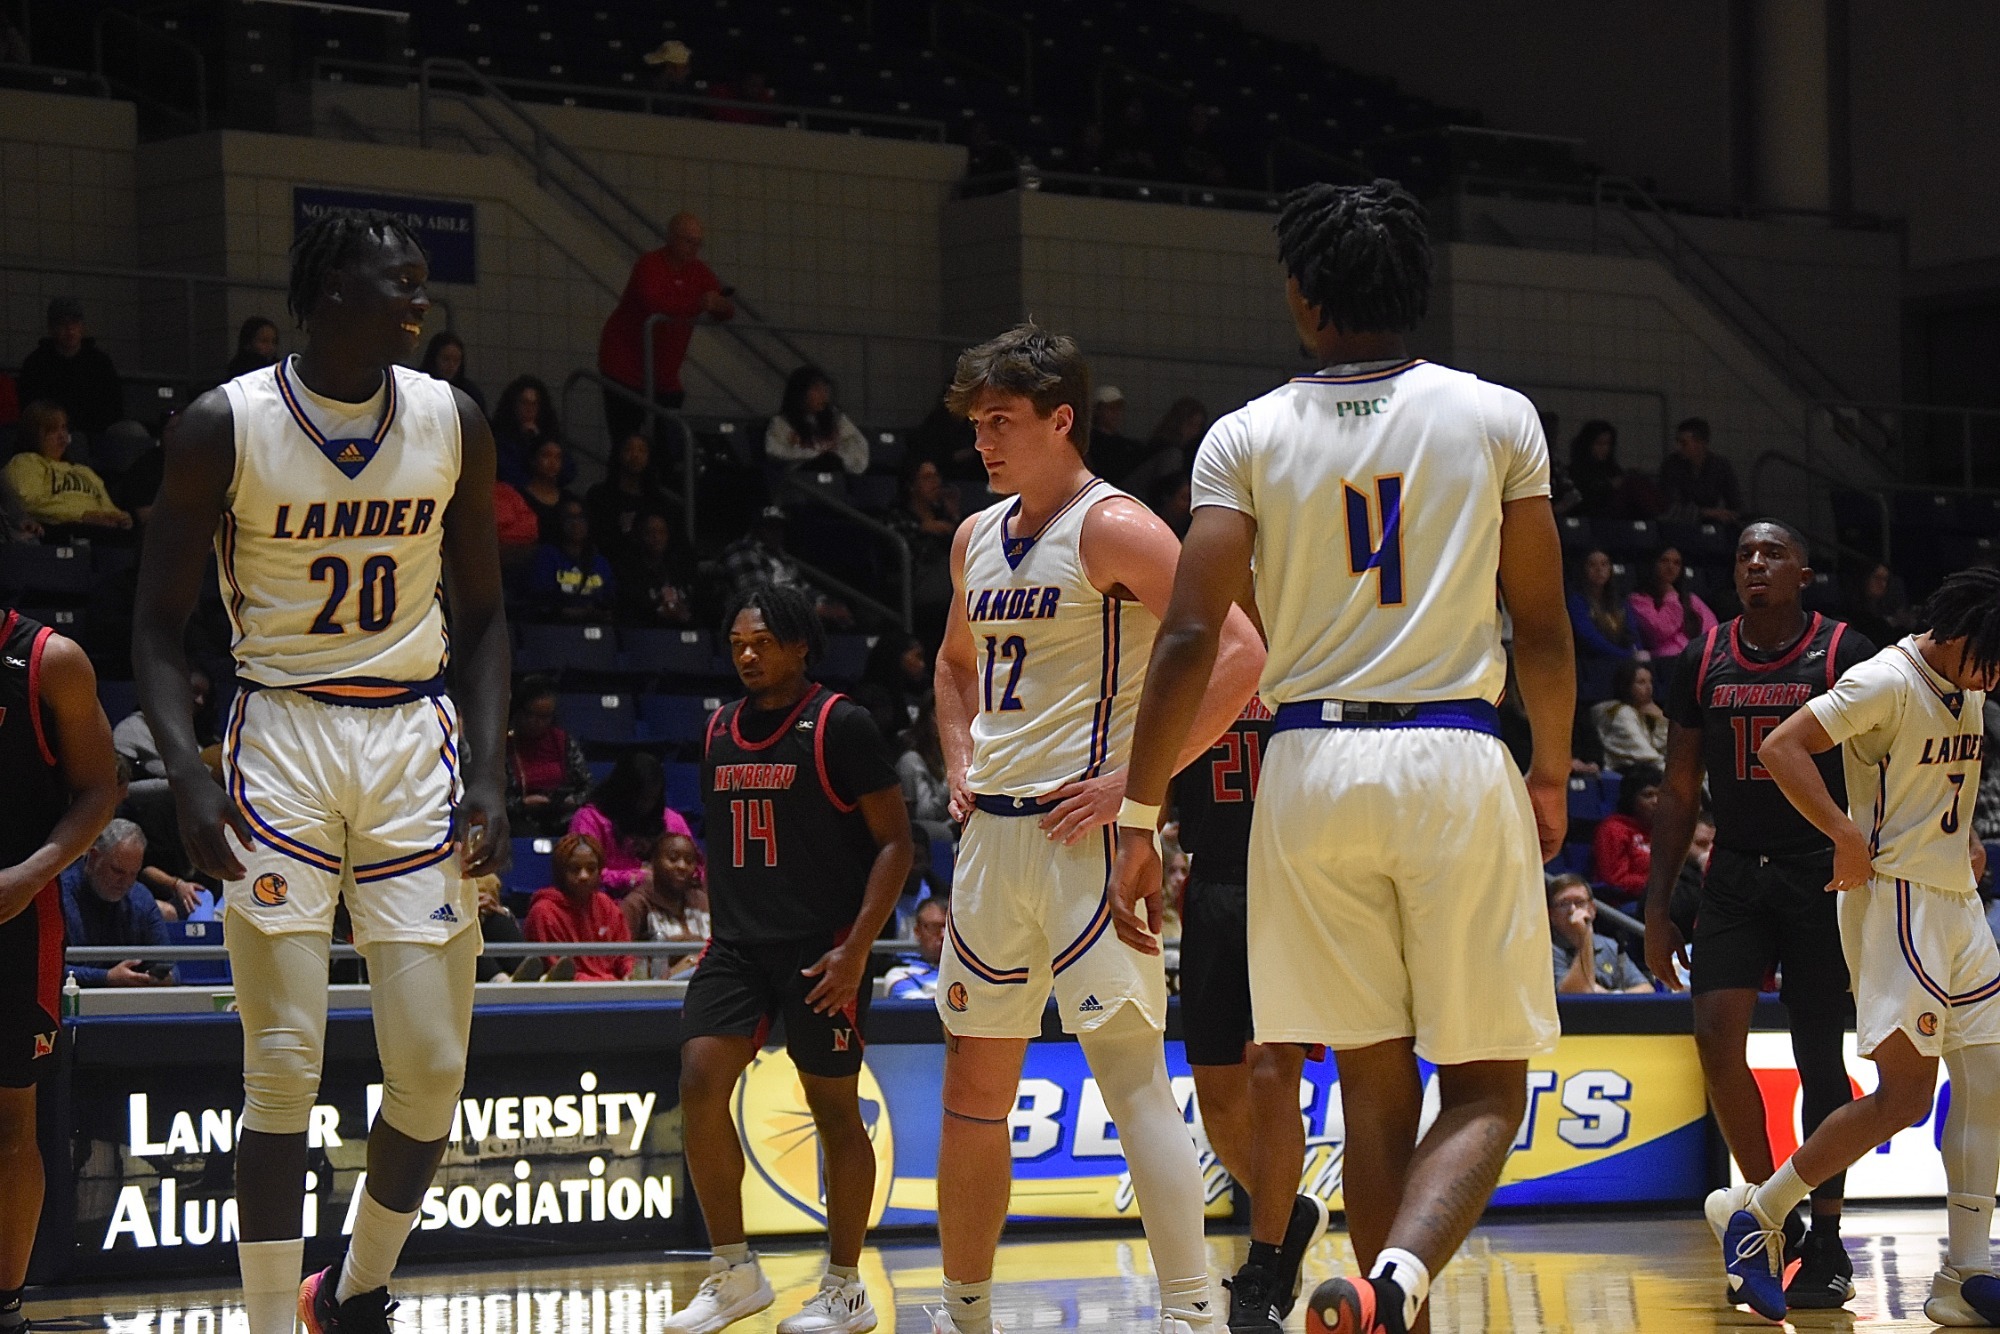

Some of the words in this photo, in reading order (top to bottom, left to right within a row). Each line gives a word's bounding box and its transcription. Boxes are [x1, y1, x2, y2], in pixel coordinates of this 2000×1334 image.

[302, 203, 324, 219] NO
[428, 216, 471, 233] AISLE
[1336, 398, 1388, 417] PBC
[271, 497, 437, 540] LANDER
[1341, 473, 1405, 607] 4
[306, 553, 398, 635] 20
[5, 655, 27, 667] SAC
[982, 634, 1027, 714] 12
[1710, 682, 1813, 708] NEWBERRY
[798, 720, 814, 729] SAC
[713, 763, 798, 792] NEWBERRY
[1211, 730, 1260, 803] 21
[730, 799, 778, 868] 14
